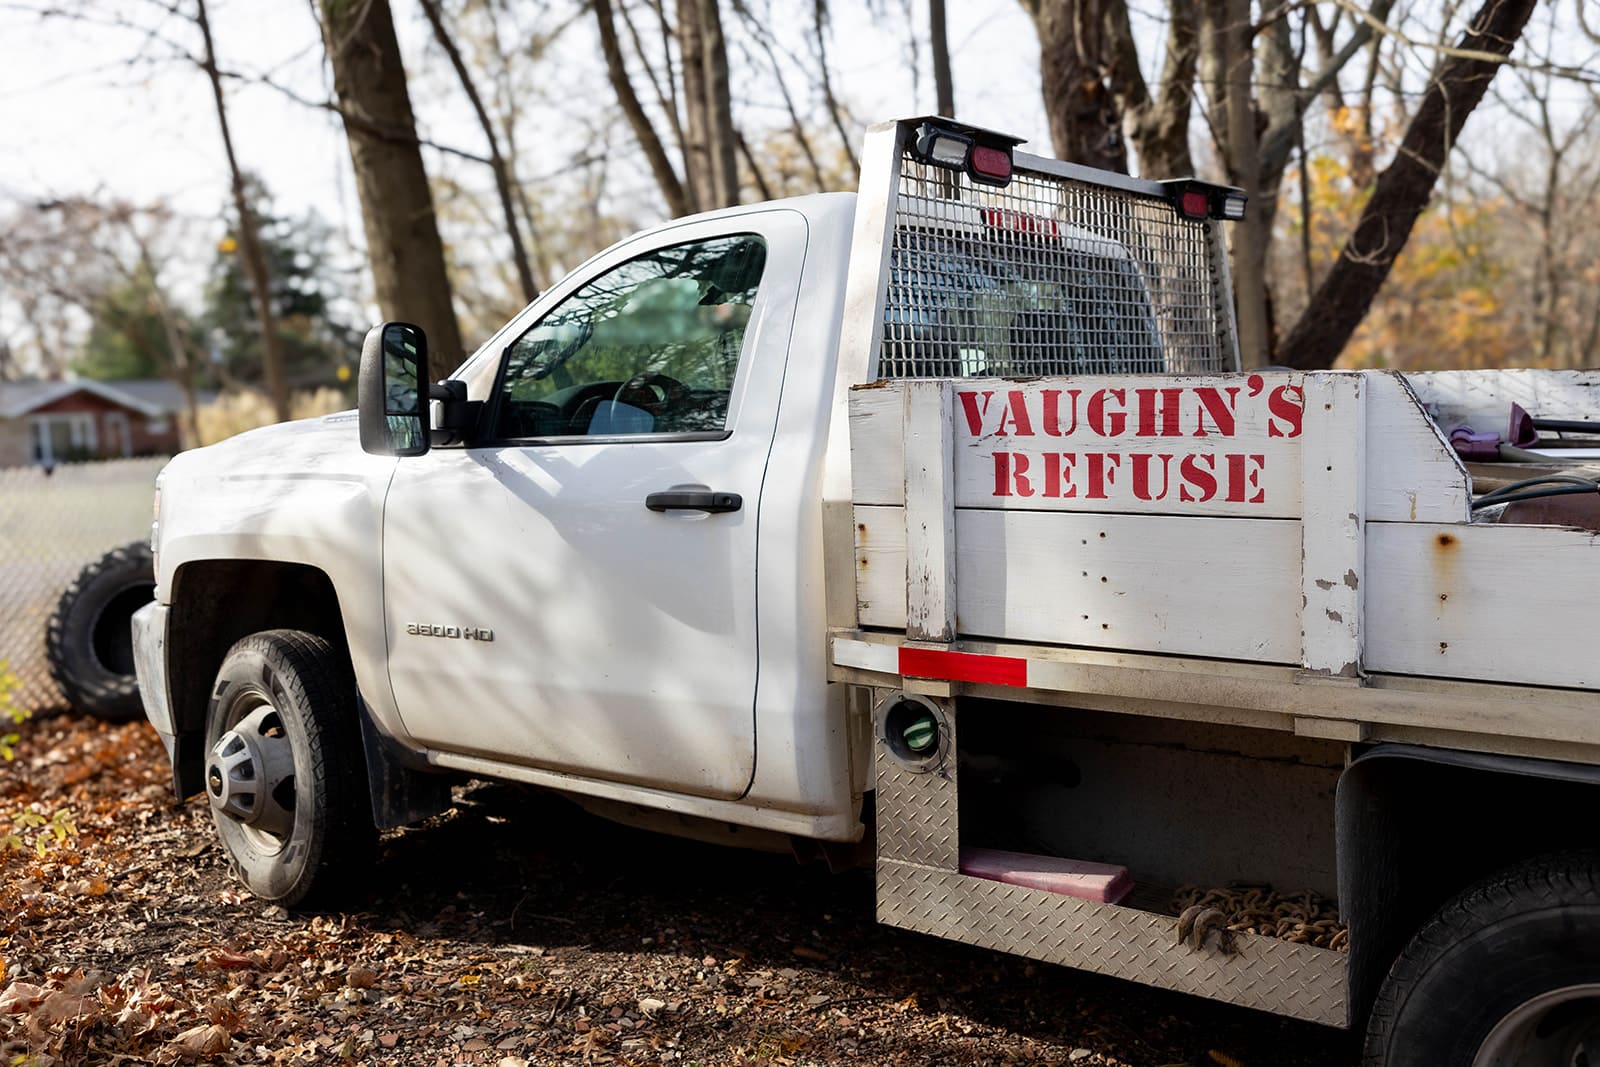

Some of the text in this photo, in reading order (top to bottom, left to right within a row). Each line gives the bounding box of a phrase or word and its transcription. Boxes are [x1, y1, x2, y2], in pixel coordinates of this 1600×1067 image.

[957, 374, 1304, 439] VAUGHN'S
[992, 452, 1265, 503] REFUSE
[407, 622, 495, 642] 3500 HD
